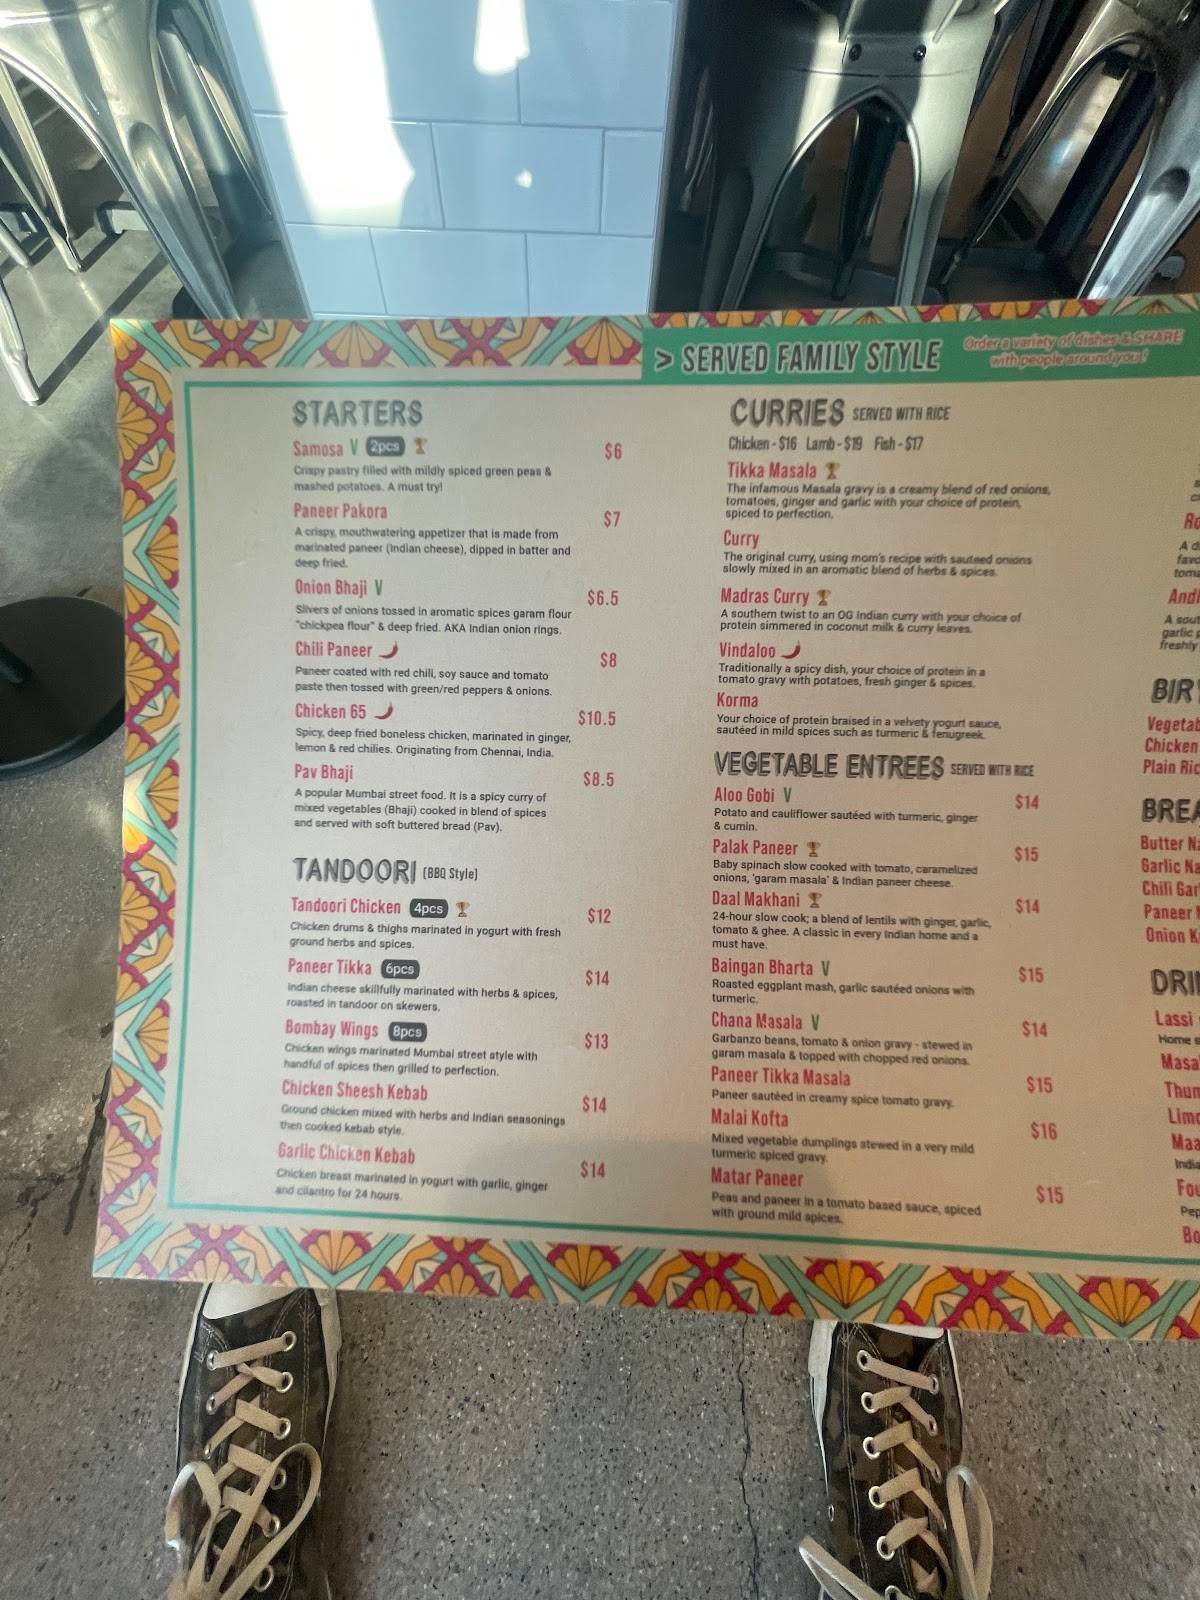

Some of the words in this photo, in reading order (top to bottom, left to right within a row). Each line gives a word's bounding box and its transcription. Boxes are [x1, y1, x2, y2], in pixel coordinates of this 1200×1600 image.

[681, 343, 769, 374] SERVED
[774, 341, 860, 373] FAMILY
[864, 338, 942, 373] STYLE
[292, 400, 423, 427] STARTERS
[731, 398, 845, 427] CURRIES
[853, 407, 892, 421] SERVED
[896, 407, 922, 420] WITH
[926, 406, 951, 420] RICE
[293, 440, 343, 456] Samosa
[350, 439, 358, 455] V
[371, 440, 399, 455] 2pcs
[605, 442, 621, 460] $6
[729, 436, 769, 450] Chicken
[806, 436, 835, 450] Lamb
[874, 436, 895, 451] Fish
[728, 462, 764, 478] Tikka
[769, 462, 816, 478] Masala
[294, 502, 338, 518] Paneer
[343, 503, 387, 519] Pakora
[604, 510, 620, 528] $7
[295, 527, 303, 536] A
[339, 528, 415, 539] mouthwatering
[419, 528, 465, 539] appetizer
[469, 528, 488, 538] that
[492, 529, 500, 538] is
[503, 530, 531, 539] made
[535, 529, 558, 539] from
[724, 530, 759, 549] Curry
[295, 579, 331, 594] Onion
[335, 580, 367, 598] Bhaji
[375, 580, 382, 596] V
[588, 589, 618, 606] $6.5
[721, 588, 768, 603] Madras
[774, 588, 809, 607] Curry
[296, 641, 323, 656] Chili
[327, 642, 372, 657] Paneer
[720, 642, 775, 658] Vindaloo
[601, 652, 616, 668] $8
[296, 666, 331, 675] Paneer
[333, 668, 367, 676] coated
[370, 668, 391, 676] with
[394, 668, 410, 677] red
[439, 671, 456, 680] soy
[492, 671, 510, 679] and
[514, 672, 548, 680] tomato
[717, 692, 758, 707] Korma
[296, 703, 346, 718] Chicken
[351, 704, 366, 719] 65
[578, 710, 615, 726] $10.5
[1145, 737, 1198, 753] Chicken
[295, 764, 317, 778] Pav
[321, 765, 353, 783] Bhaji
[714, 751, 838, 778] VEGETABLE
[846, 754, 944, 780] ENTREES
[950, 764, 985, 775] SERVED
[988, 764, 1011, 776] WITH
[1014, 765, 1034, 776] RICE
[1143, 759, 1176, 774] Plain
[584, 771, 614, 787] $8.5
[715, 787, 742, 802] Aloo
[747, 788, 774, 802] Gobi
[784, 787, 792, 803] V
[1016, 794, 1039, 810] $14
[714, 808, 747, 817] Potato
[751, 809, 768, 817] and
[772, 809, 827, 818] cauliflower
[874, 812, 895, 820] with
[946, 814, 978, 824] ginger
[713, 839, 748, 854] Palak
[753, 840, 798, 855] Paneer
[1141, 835, 1184, 851] Butter
[1015, 846, 1039, 862] $15
[293, 858, 416, 884] TANDOORI
[1141, 858, 1181, 874] Garlic
[1143, 880, 1172, 896] Chili
[292, 897, 346, 912] Tandoori
[351, 898, 400, 914] Chicken
[413, 902, 443, 917] 4pcs
[713, 891, 740, 905] Daal
[745, 891, 799, 907] Makhani
[1016, 899, 1040, 914] $14
[588, 908, 611, 924] $12
[1144, 904, 1192, 920] Paneer
[290, 922, 330, 931] Chicken
[333, 923, 364, 932] drums
[368, 924, 374, 932] &
[378, 924, 408, 935] thighs
[411, 926, 461, 934] marinated
[465, 925, 473, 935] in
[477, 928, 508, 937] yogurt
[512, 927, 532, 936] with
[536, 927, 561, 936] fresh
[1146, 927, 1185, 943] Onion
[288, 958, 333, 973] Paneer
[337, 959, 371, 975] Tikka
[385, 962, 416, 977] 6pcs
[712, 958, 764, 976] Baingan
[769, 960, 813, 975] Bharta
[821, 960, 830, 976] V
[1019, 966, 1044, 983] $15
[586, 970, 609, 986] $14
[713, 979, 754, 989] Roasted
[757, 981, 802, 992] eggplant
[839, 983, 868, 994] garlic
[915, 985, 950, 995] onions
[952, 987, 975, 995] with
[712, 1011, 752, 1028] Chana
[756, 1013, 802, 1030] Masala
[811, 1014, 819, 1031] V
[1155, 1010, 1193, 1027] Lassi
[285, 1019, 336, 1039] Bombay
[341, 1021, 378, 1040] Wings
[393, 1025, 422, 1040] 8pcs
[1022, 1021, 1047, 1037] $14
[585, 1032, 608, 1049] $13
[1158, 1034, 1191, 1045] Home
[712, 1066, 758, 1083] Paneer
[763, 1068, 799, 1084] Tikka
[803, 1069, 850, 1086] Masala
[282, 1080, 333, 1096] Chicken
[337, 1081, 383, 1099] Sheesh
[388, 1084, 427, 1101] Kebab
[1027, 1076, 1053, 1093] $15
[583, 1096, 606, 1112] $14
[712, 1108, 746, 1125] Malai
[752, 1110, 788, 1127] Kofta
[1031, 1122, 1057, 1140] $16
[278, 1142, 315, 1159] Garlic
[320, 1144, 371, 1162] Chicken
[375, 1147, 415, 1164] Kebab
[581, 1160, 605, 1178] $14
[712, 1167, 751, 1184] Matar
[756, 1169, 803, 1187] Paneer
[1036, 1185, 1064, 1204] $15
